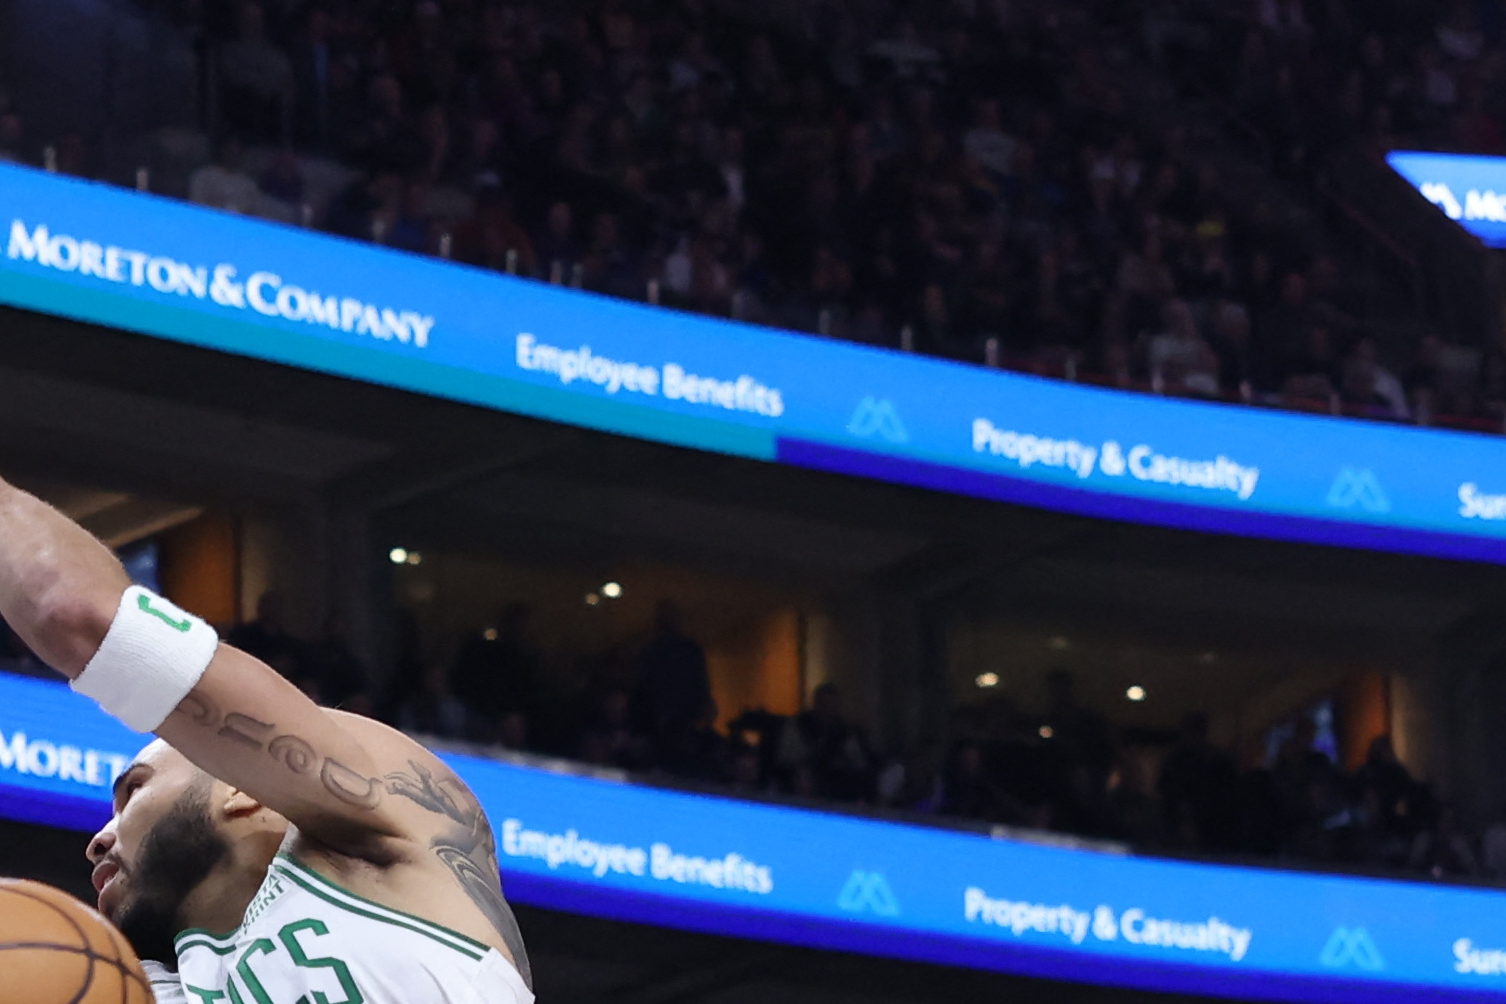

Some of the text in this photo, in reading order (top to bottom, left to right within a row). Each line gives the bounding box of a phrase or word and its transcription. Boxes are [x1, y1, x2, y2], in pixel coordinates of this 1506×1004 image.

[516, 332, 784, 417] Employee Benefits
[972, 418, 1097, 478] Property
[1128, 445, 1259, 499] Casualty
[502, 818, 773, 894] Employee Benefits
[964, 887, 1091, 944] Property
[1120, 908, 1252, 961] Casualty
